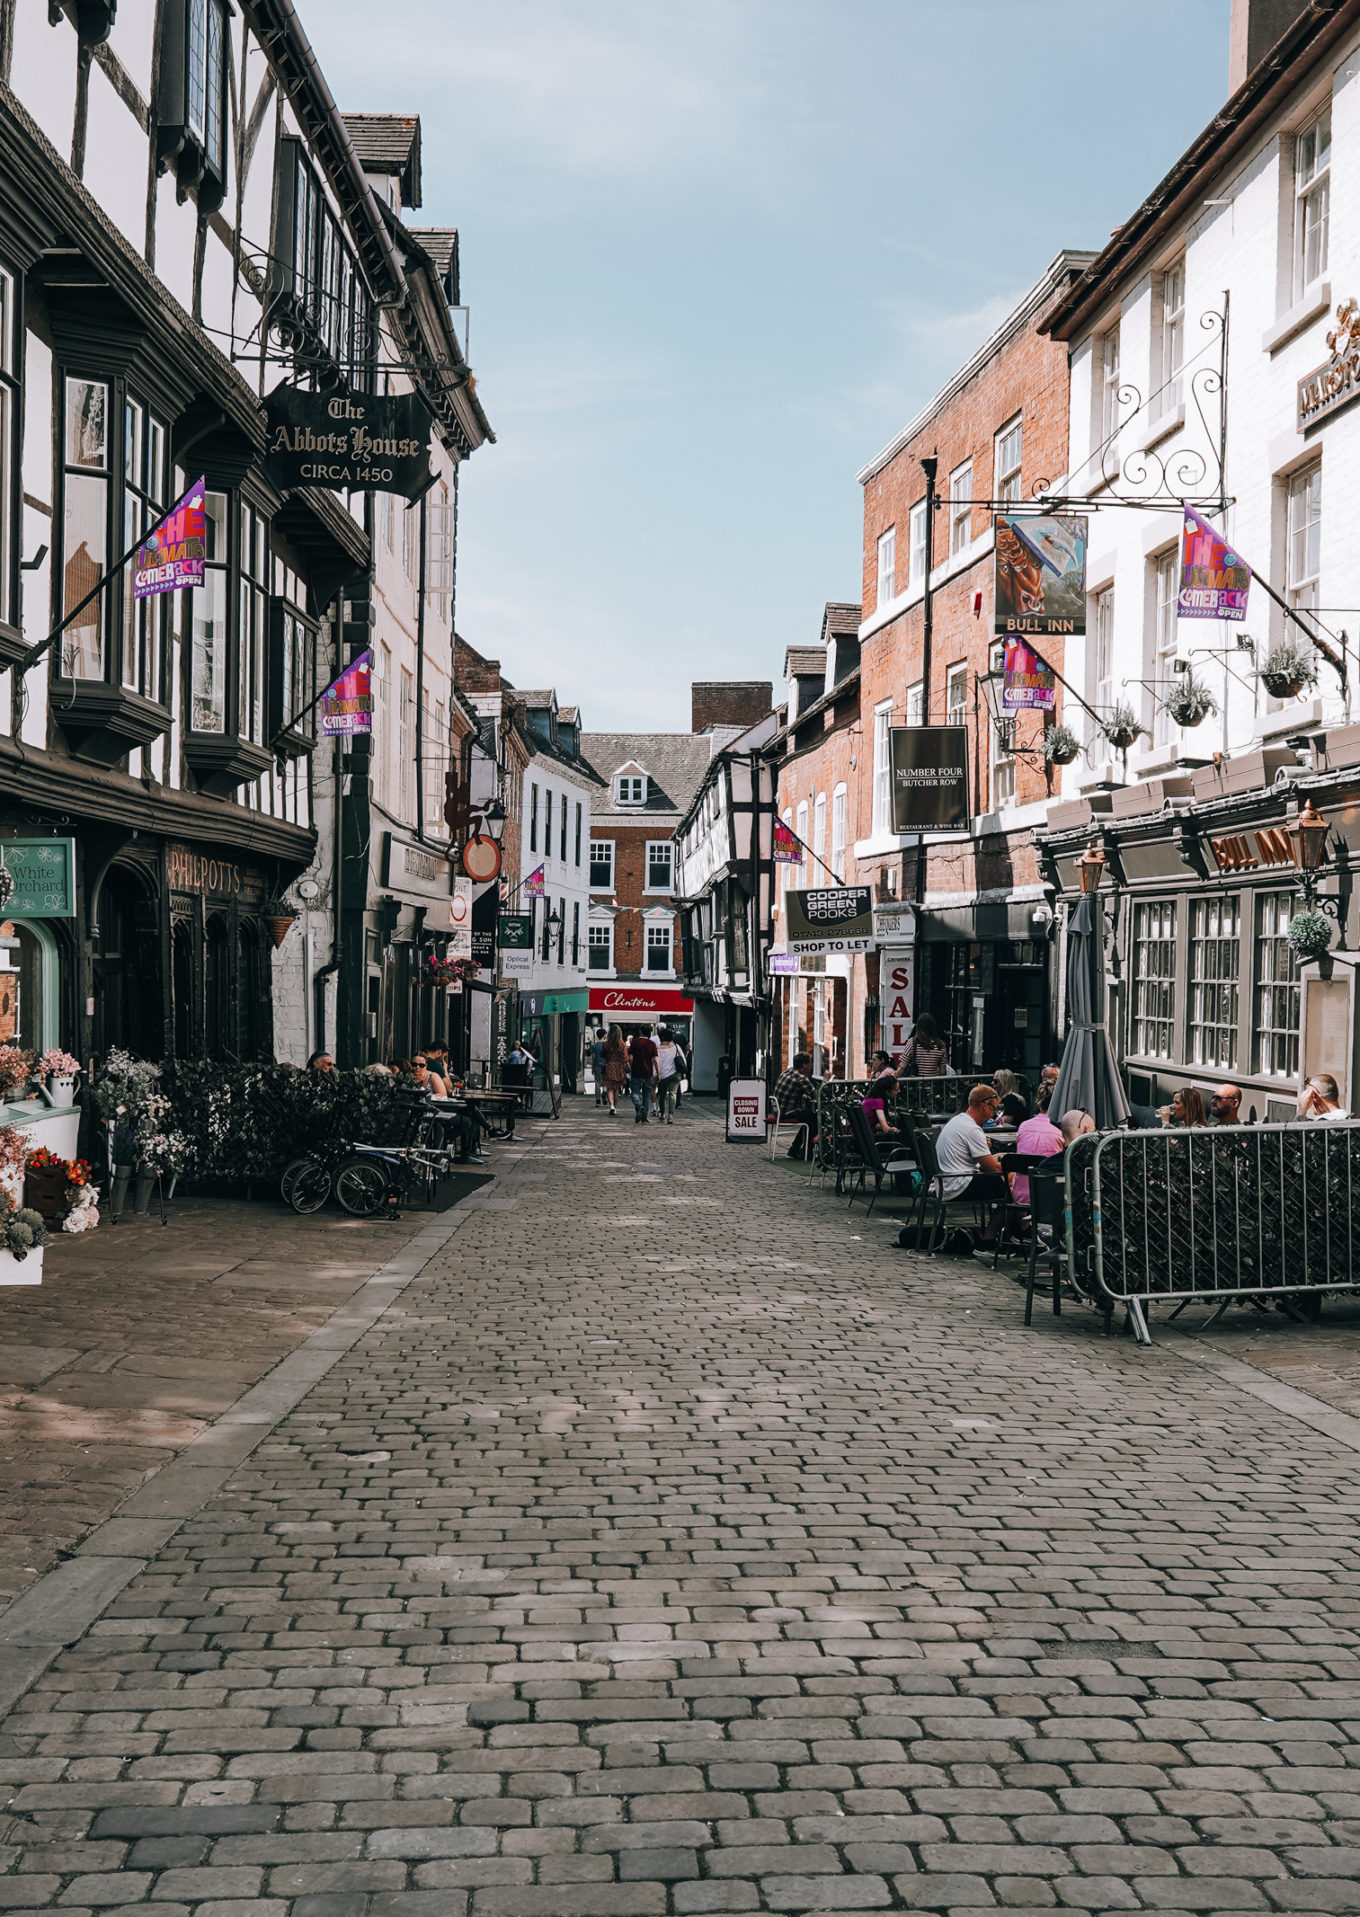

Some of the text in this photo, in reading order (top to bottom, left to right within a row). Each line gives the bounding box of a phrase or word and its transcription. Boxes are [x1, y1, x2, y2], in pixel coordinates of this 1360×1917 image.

[328, 397, 365, 420] The
[270, 425, 420, 463] Abbots House
[300, 464, 393, 482] CIRCA 1450
[156, 501, 205, 547] THE
[1184, 525, 1226, 570] THE
[175, 577, 202, 585] OPEN
[1217, 608, 1243, 620] OPEN
[1007, 618, 1074, 632] BULL INN
[1005, 641, 1038, 675] THE
[335, 668, 371, 701] THE
[1033, 701, 1053, 709] OPEN
[896, 767, 963, 777] NUMBER FOUR
[902, 778, 958, 787] BUTCHER ROW
[1211, 834, 1259, 869] BULL
[13, 867, 55, 879] White
[171, 851, 240, 893] PHILPOTTS
[806, 889, 868, 901] COOPER
[807, 899, 857, 911] GREEN
[808, 908, 858, 920] POOKS
[792, 930, 824, 939] 01743
[793, 940, 869, 953] SHOP TO LET
[506, 955, 529, 963] Optical
[604, 991, 656, 1007] Clintons
[734, 1116, 757, 1128] SALE
